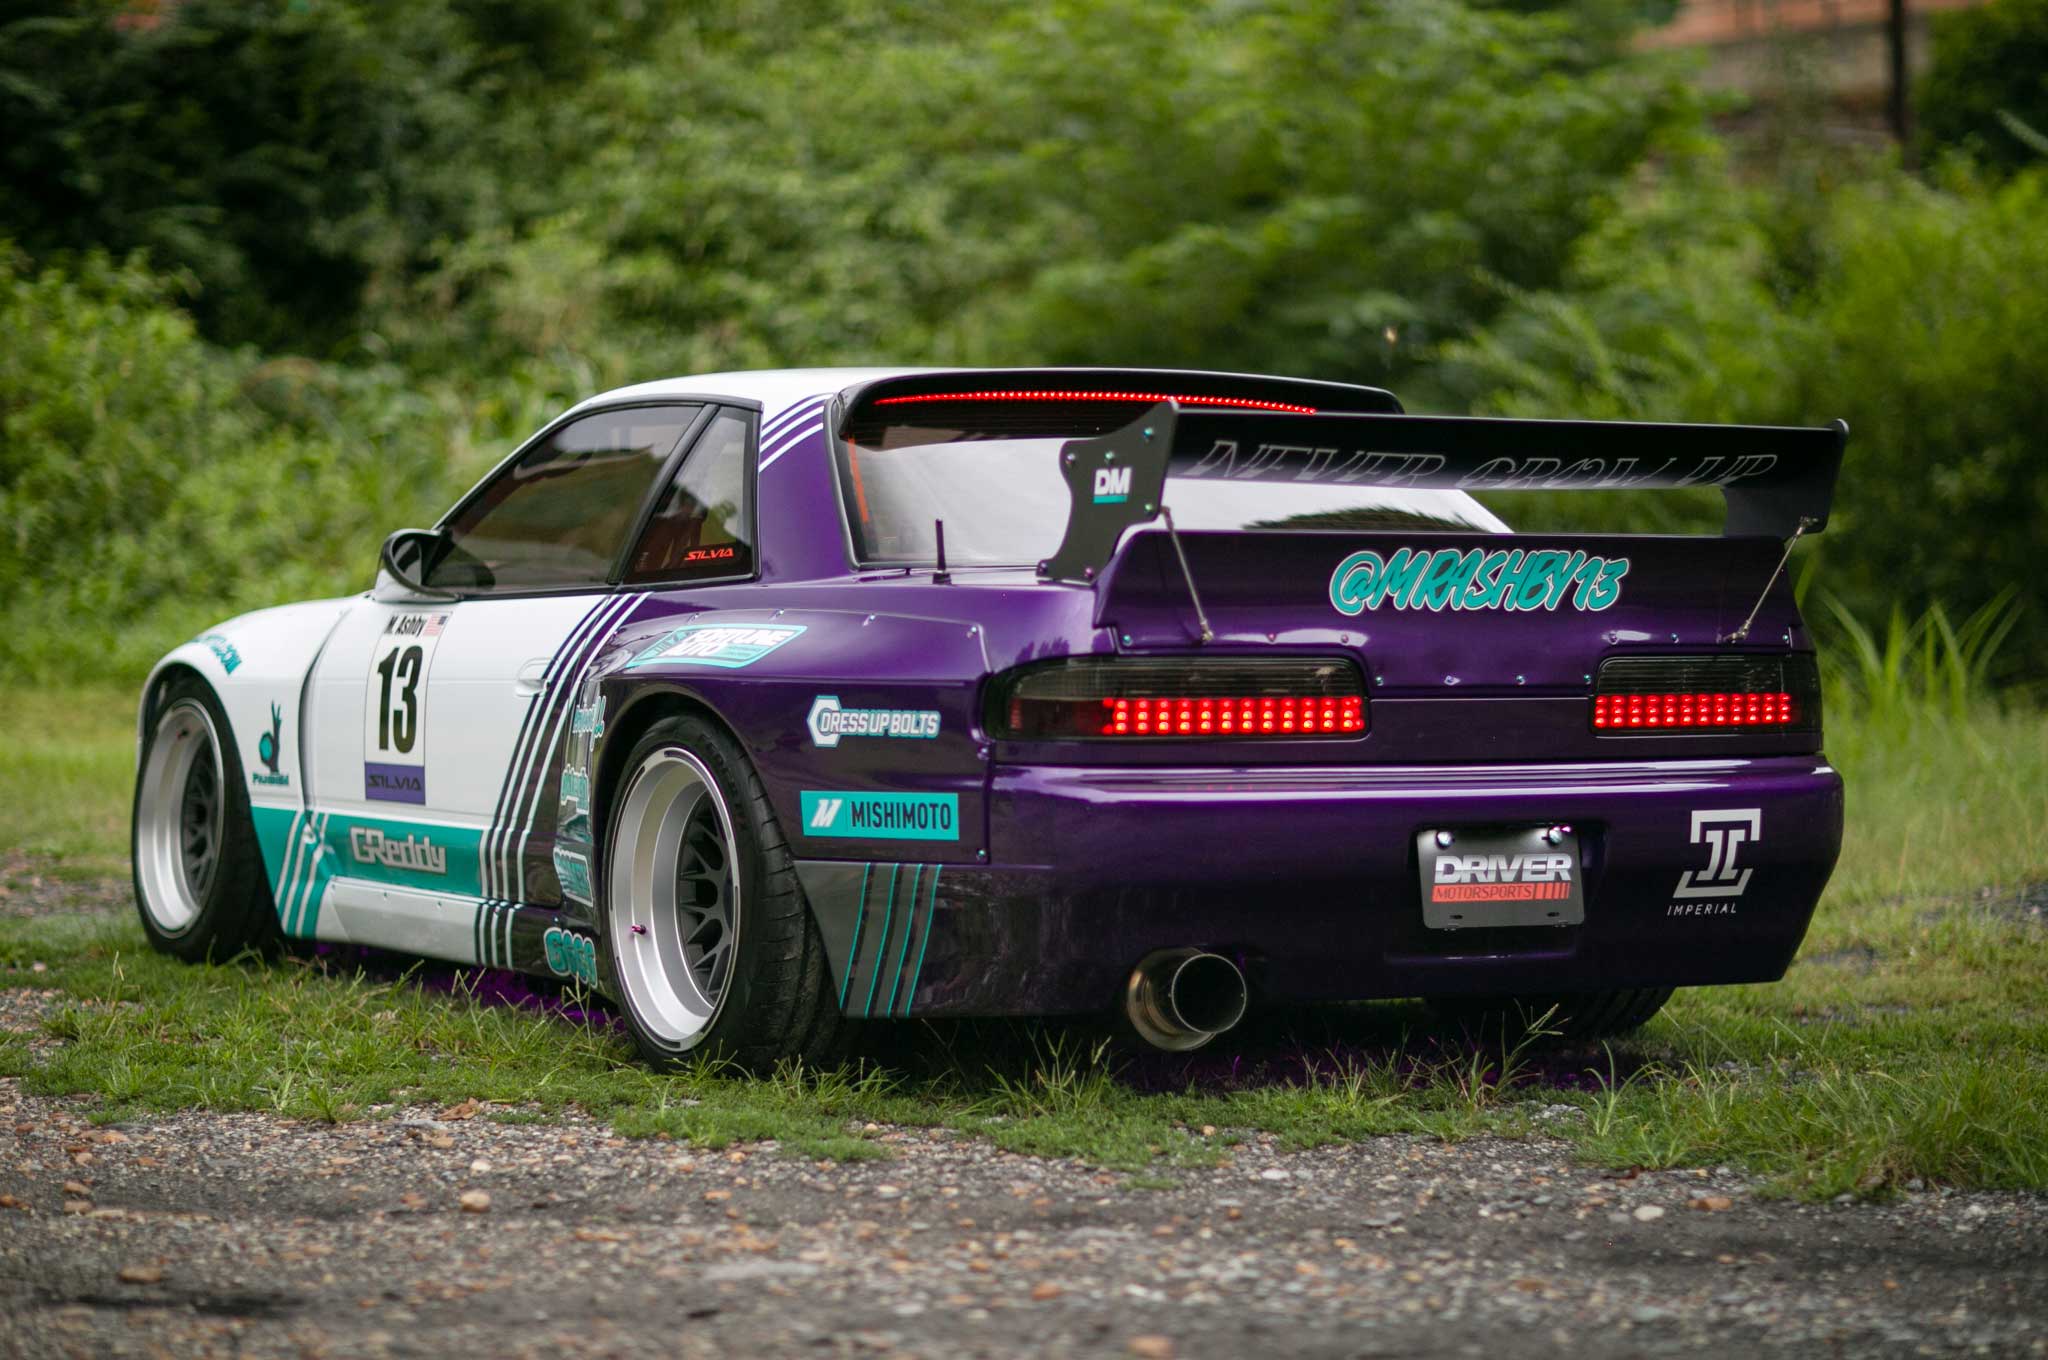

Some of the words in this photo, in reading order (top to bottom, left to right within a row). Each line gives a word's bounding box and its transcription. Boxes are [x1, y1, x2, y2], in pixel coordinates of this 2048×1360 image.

[1094, 467, 1131, 496] DM
[685, 548, 734, 561] SILVIA
[1328, 547, 1631, 616] @MRASHBY13
[377, 645, 423, 753] 13
[368, 776, 422, 791] SILVIA
[851, 801, 951, 830] MISHIMOTO
[349, 825, 446, 874] GReddy
[1435, 853, 1572, 884] DRIVER
[1435, 885, 1533, 901] MOTORSPORTS
[1667, 903, 1737, 917] IMPERIAL
